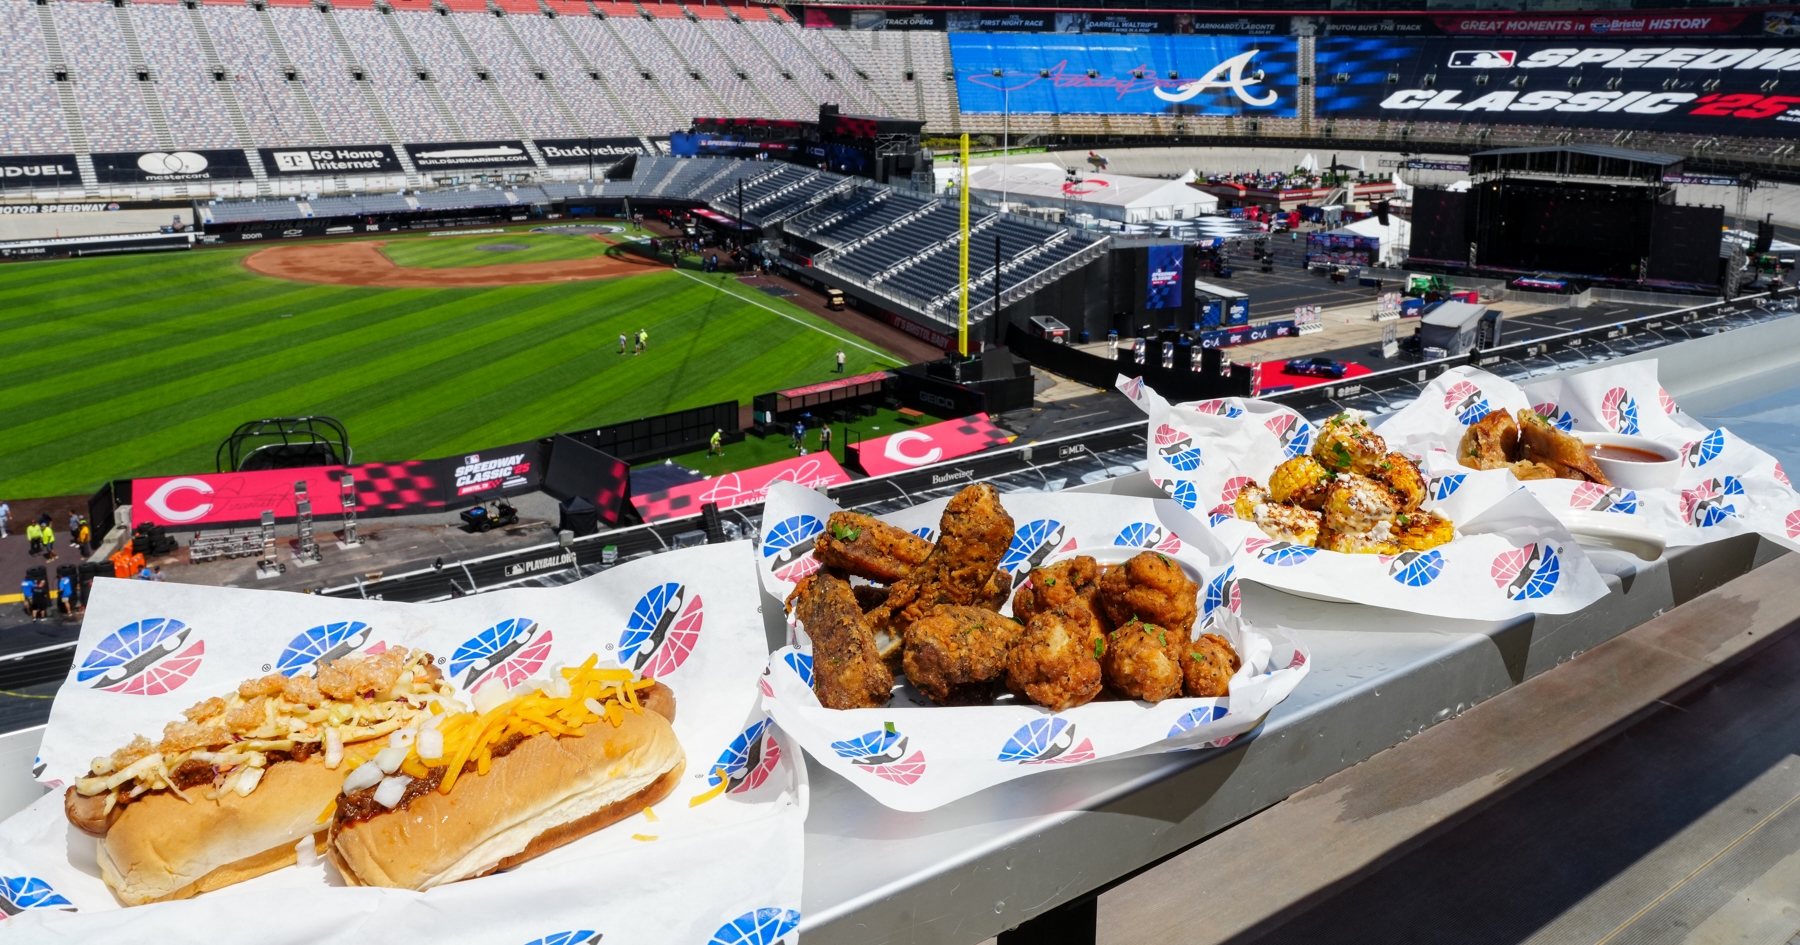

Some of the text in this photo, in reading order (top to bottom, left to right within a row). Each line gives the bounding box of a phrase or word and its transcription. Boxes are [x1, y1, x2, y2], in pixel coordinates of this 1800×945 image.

[1121, 21, 1158, 29] WALTRIP'S
[1195, 23, 1275, 31] EARNHARDT/LABONTE
[1460, 18, 1711, 31] GREAT MOMENTS in Bristol HISTORY
[1379, 89, 1800, 119] CLASSIC '25
[311, 149, 383, 162] 5G Home
[543, 145, 642, 157] Budweiser
[315, 159, 381, 170] Internet
[418, 155, 528, 165] BUILDSUBMARINES.COM
[0, 165, 73, 177] DUEL
[145, 172, 209, 181] mastercard
[41, 204, 106, 213] SPEEDWAY
[366, 224, 379, 232] FOX
[894, 317, 950, 349] IT'S BRISTOL BABY
[919, 391, 954, 409] GEICO
[884, 430, 943, 466] C
[1069, 444, 1085, 455] MLB
[455, 454, 525, 477] SPEEDWAY
[456, 466, 513, 487] CLASSIC
[513, 462, 531, 474] '25
[932, 469, 974, 484] Budweiser
[145, 478, 214, 522] C
